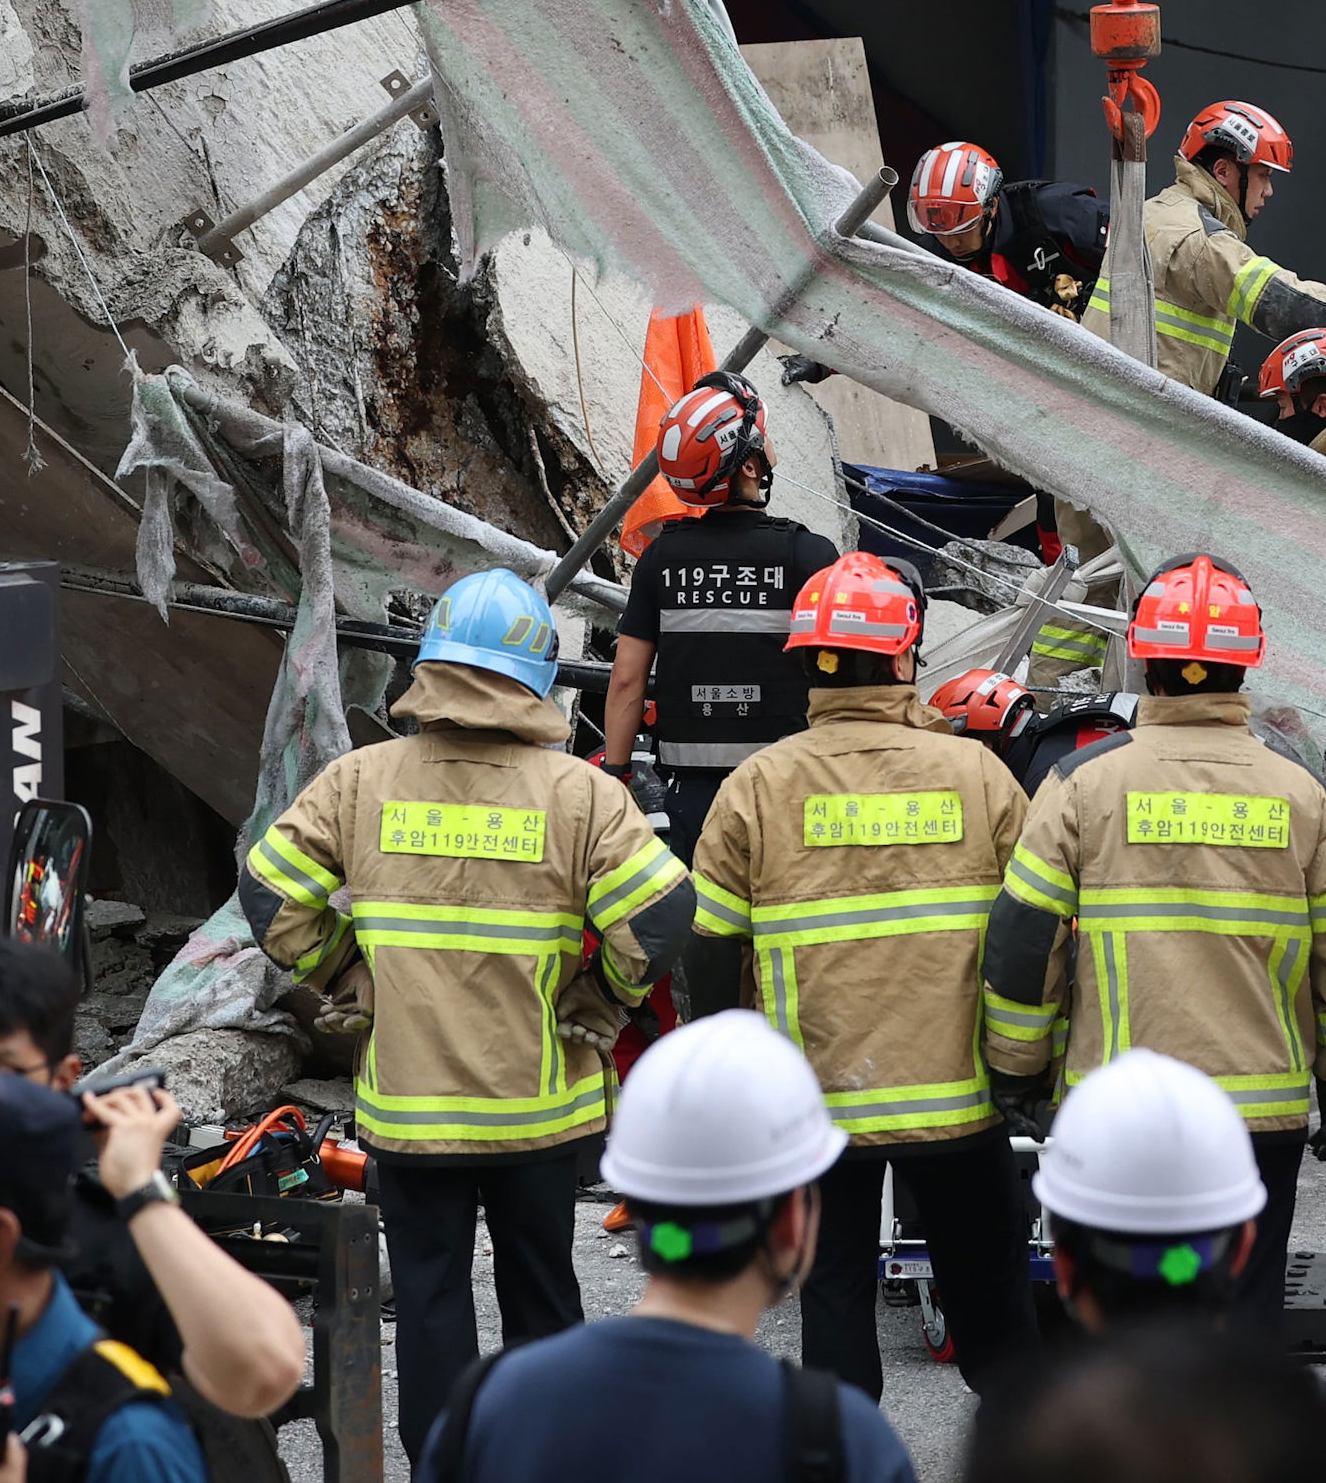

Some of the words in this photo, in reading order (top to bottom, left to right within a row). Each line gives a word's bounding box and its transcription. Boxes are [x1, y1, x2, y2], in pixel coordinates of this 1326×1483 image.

[661, 564, 785, 590] 119구조대
[676, 590, 768, 605] RESCUE
[695, 687, 755, 700] 서울소방
[810, 819, 957, 839] 후암119안전센터
[1136, 819, 1284, 843] 후암119안전센터
[389, 828, 538, 855] 후암119안전센터
